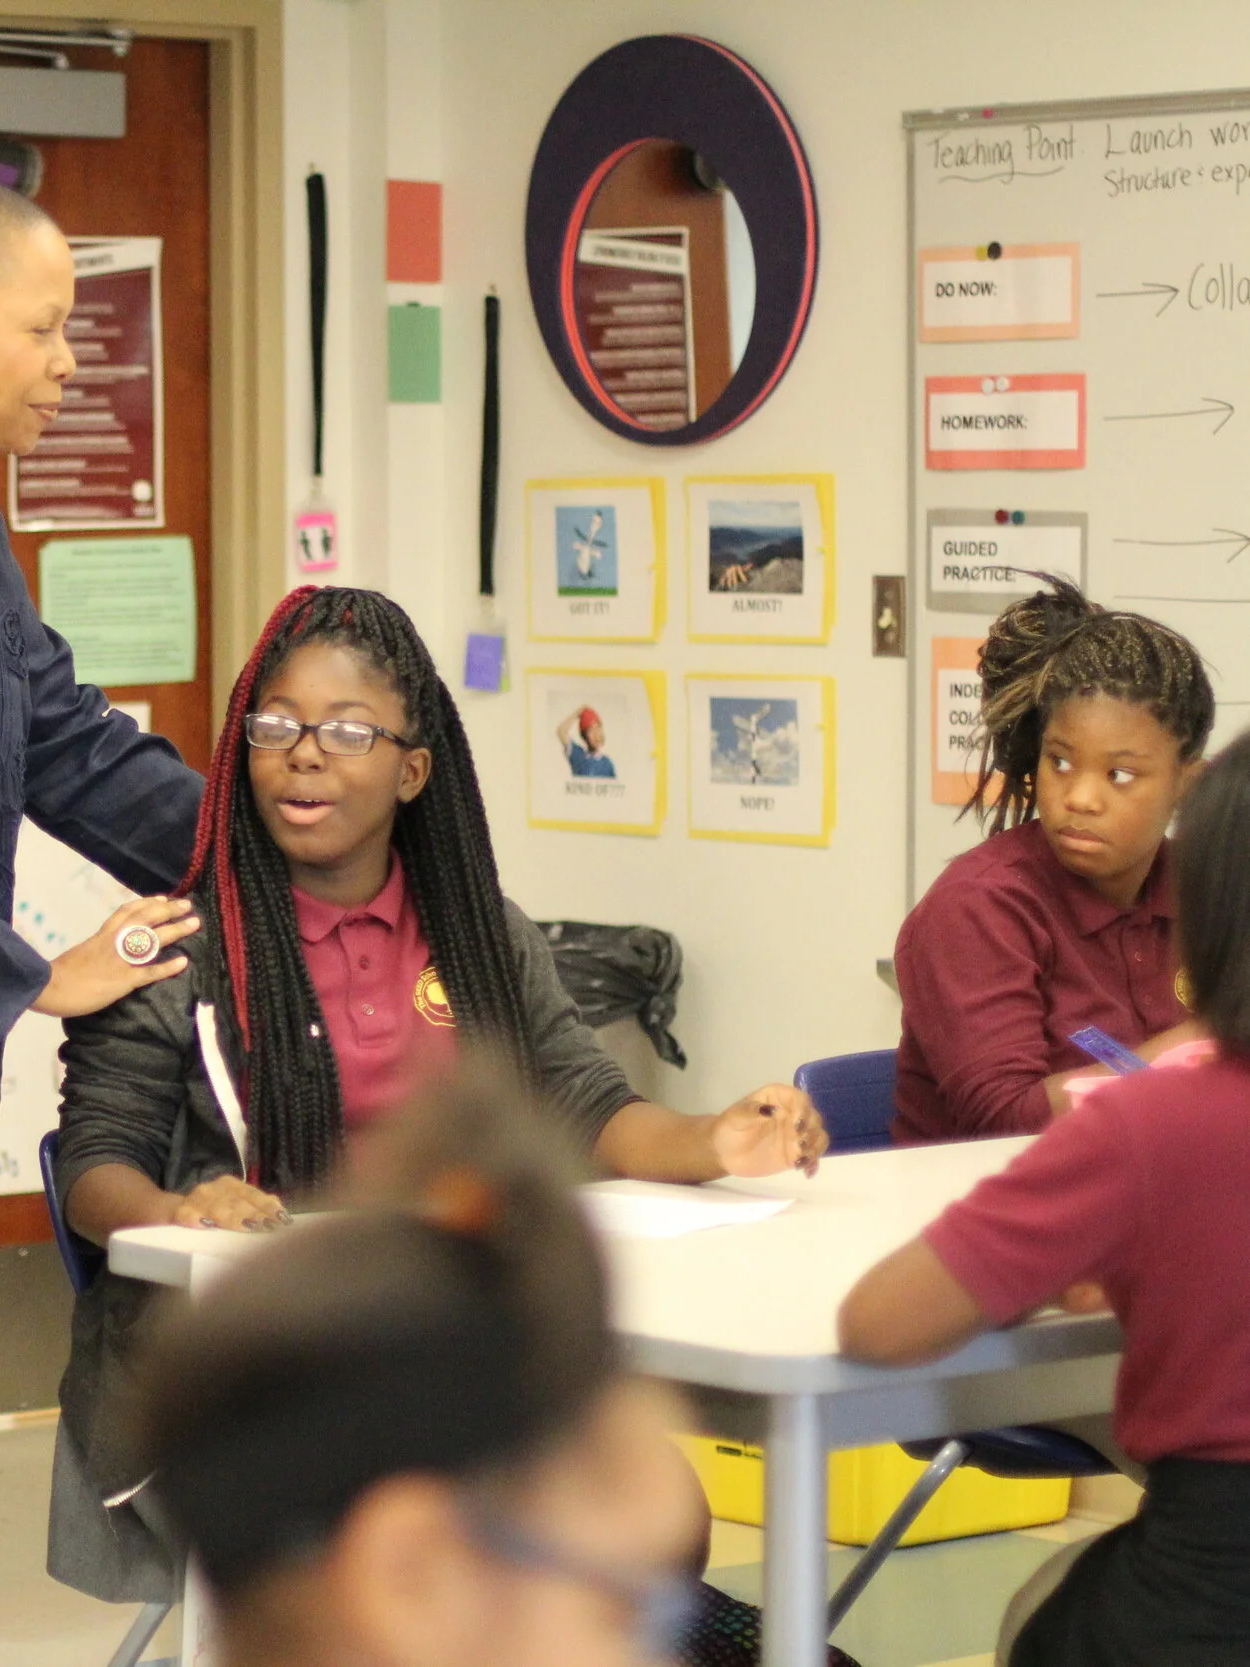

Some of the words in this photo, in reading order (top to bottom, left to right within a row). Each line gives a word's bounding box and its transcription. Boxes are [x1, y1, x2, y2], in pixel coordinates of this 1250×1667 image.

[1105, 122, 1193, 158] Launch
[927, 130, 1015, 185] Teaching
[936, 282, 955, 297] DO
[959, 281, 998, 297] NOW:
[941, 414, 1028, 431] HOMEWORK:
[943, 540, 998, 557] GUIDED
[570, 602, 590, 617] GOT
[565, 781, 592, 797] KIND
